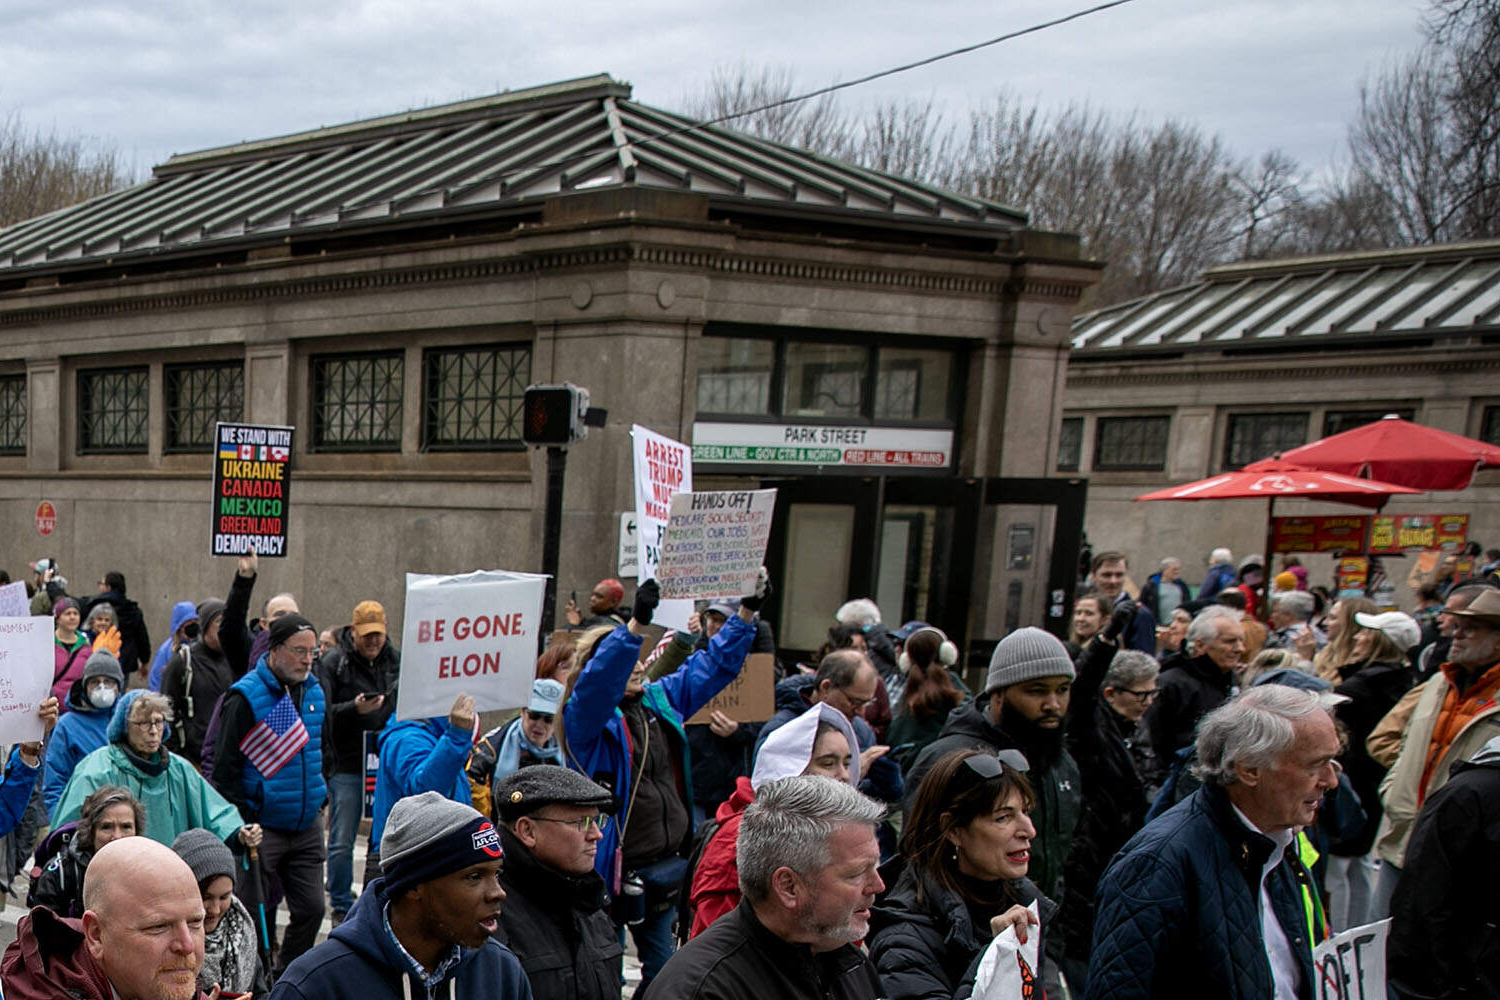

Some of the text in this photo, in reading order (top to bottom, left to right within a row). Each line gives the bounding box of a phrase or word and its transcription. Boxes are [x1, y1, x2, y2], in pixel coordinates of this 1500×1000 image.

[221, 427, 290, 446] WE STAND WITH
[784, 427, 867, 444] PARK STREET
[645, 438, 684, 469] ARREST
[725, 447, 748, 460] LINE
[755, 448, 776, 460] GOV
[807, 450, 839, 462] NORTH
[845, 451, 865, 463] RED
[867, 452, 887, 463] LINE
[911, 452, 942, 464] TRAINS
[222, 460, 284, 480] UKRAINE
[648, 461, 683, 487] TRUMP
[221, 479, 283, 498] CANADA
[652, 483, 673, 504] MUS
[220, 497, 282, 517] MEXICO
[691, 493, 754, 514] HANDS OFF!
[220, 516, 282, 534] GREENLAND
[215, 534, 284, 555] DEMOCRACY
[417, 613, 526, 643] BE GONE,
[438, 652, 501, 679] ELON
